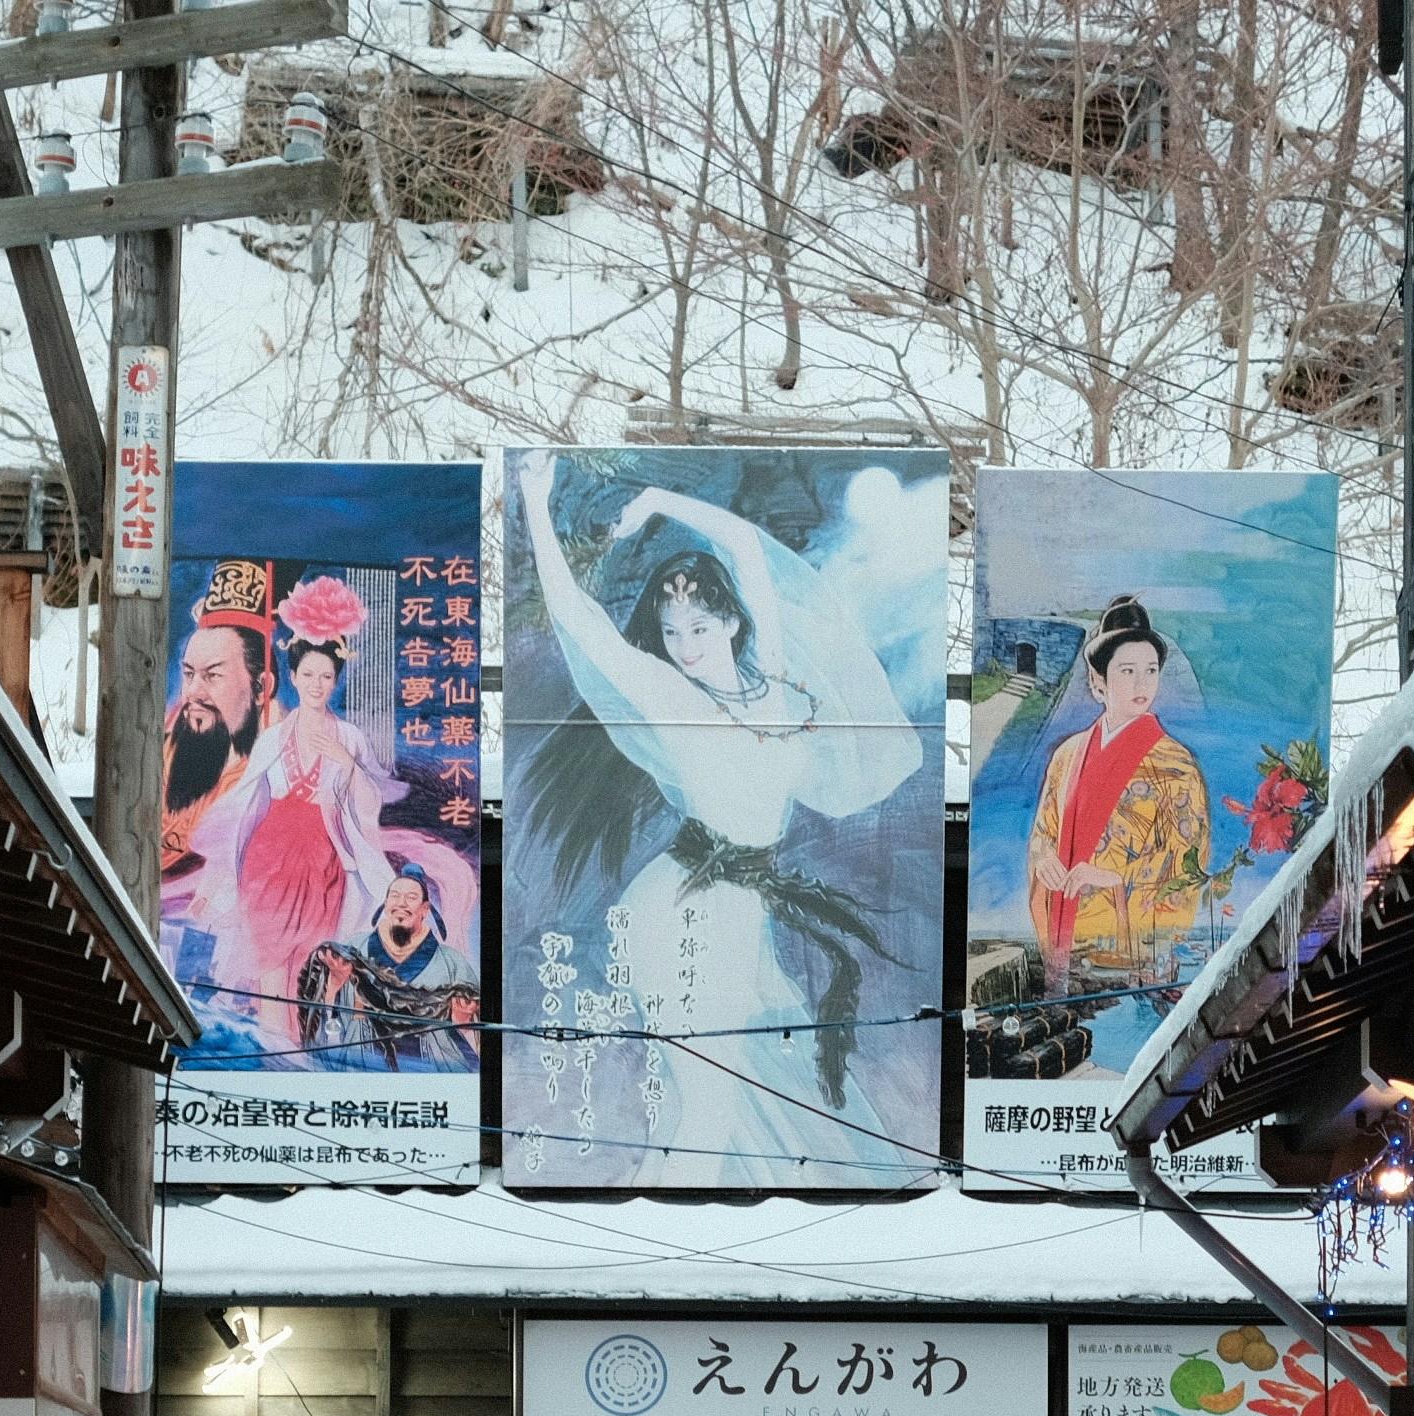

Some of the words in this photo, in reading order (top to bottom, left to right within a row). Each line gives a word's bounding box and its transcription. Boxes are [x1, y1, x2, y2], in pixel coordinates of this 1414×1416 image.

[121, 443, 161, 549] 味えさ
[692, 1337, 968, 1397] えんがわ
[1076, 1376, 1166, 1398] 地方発送
